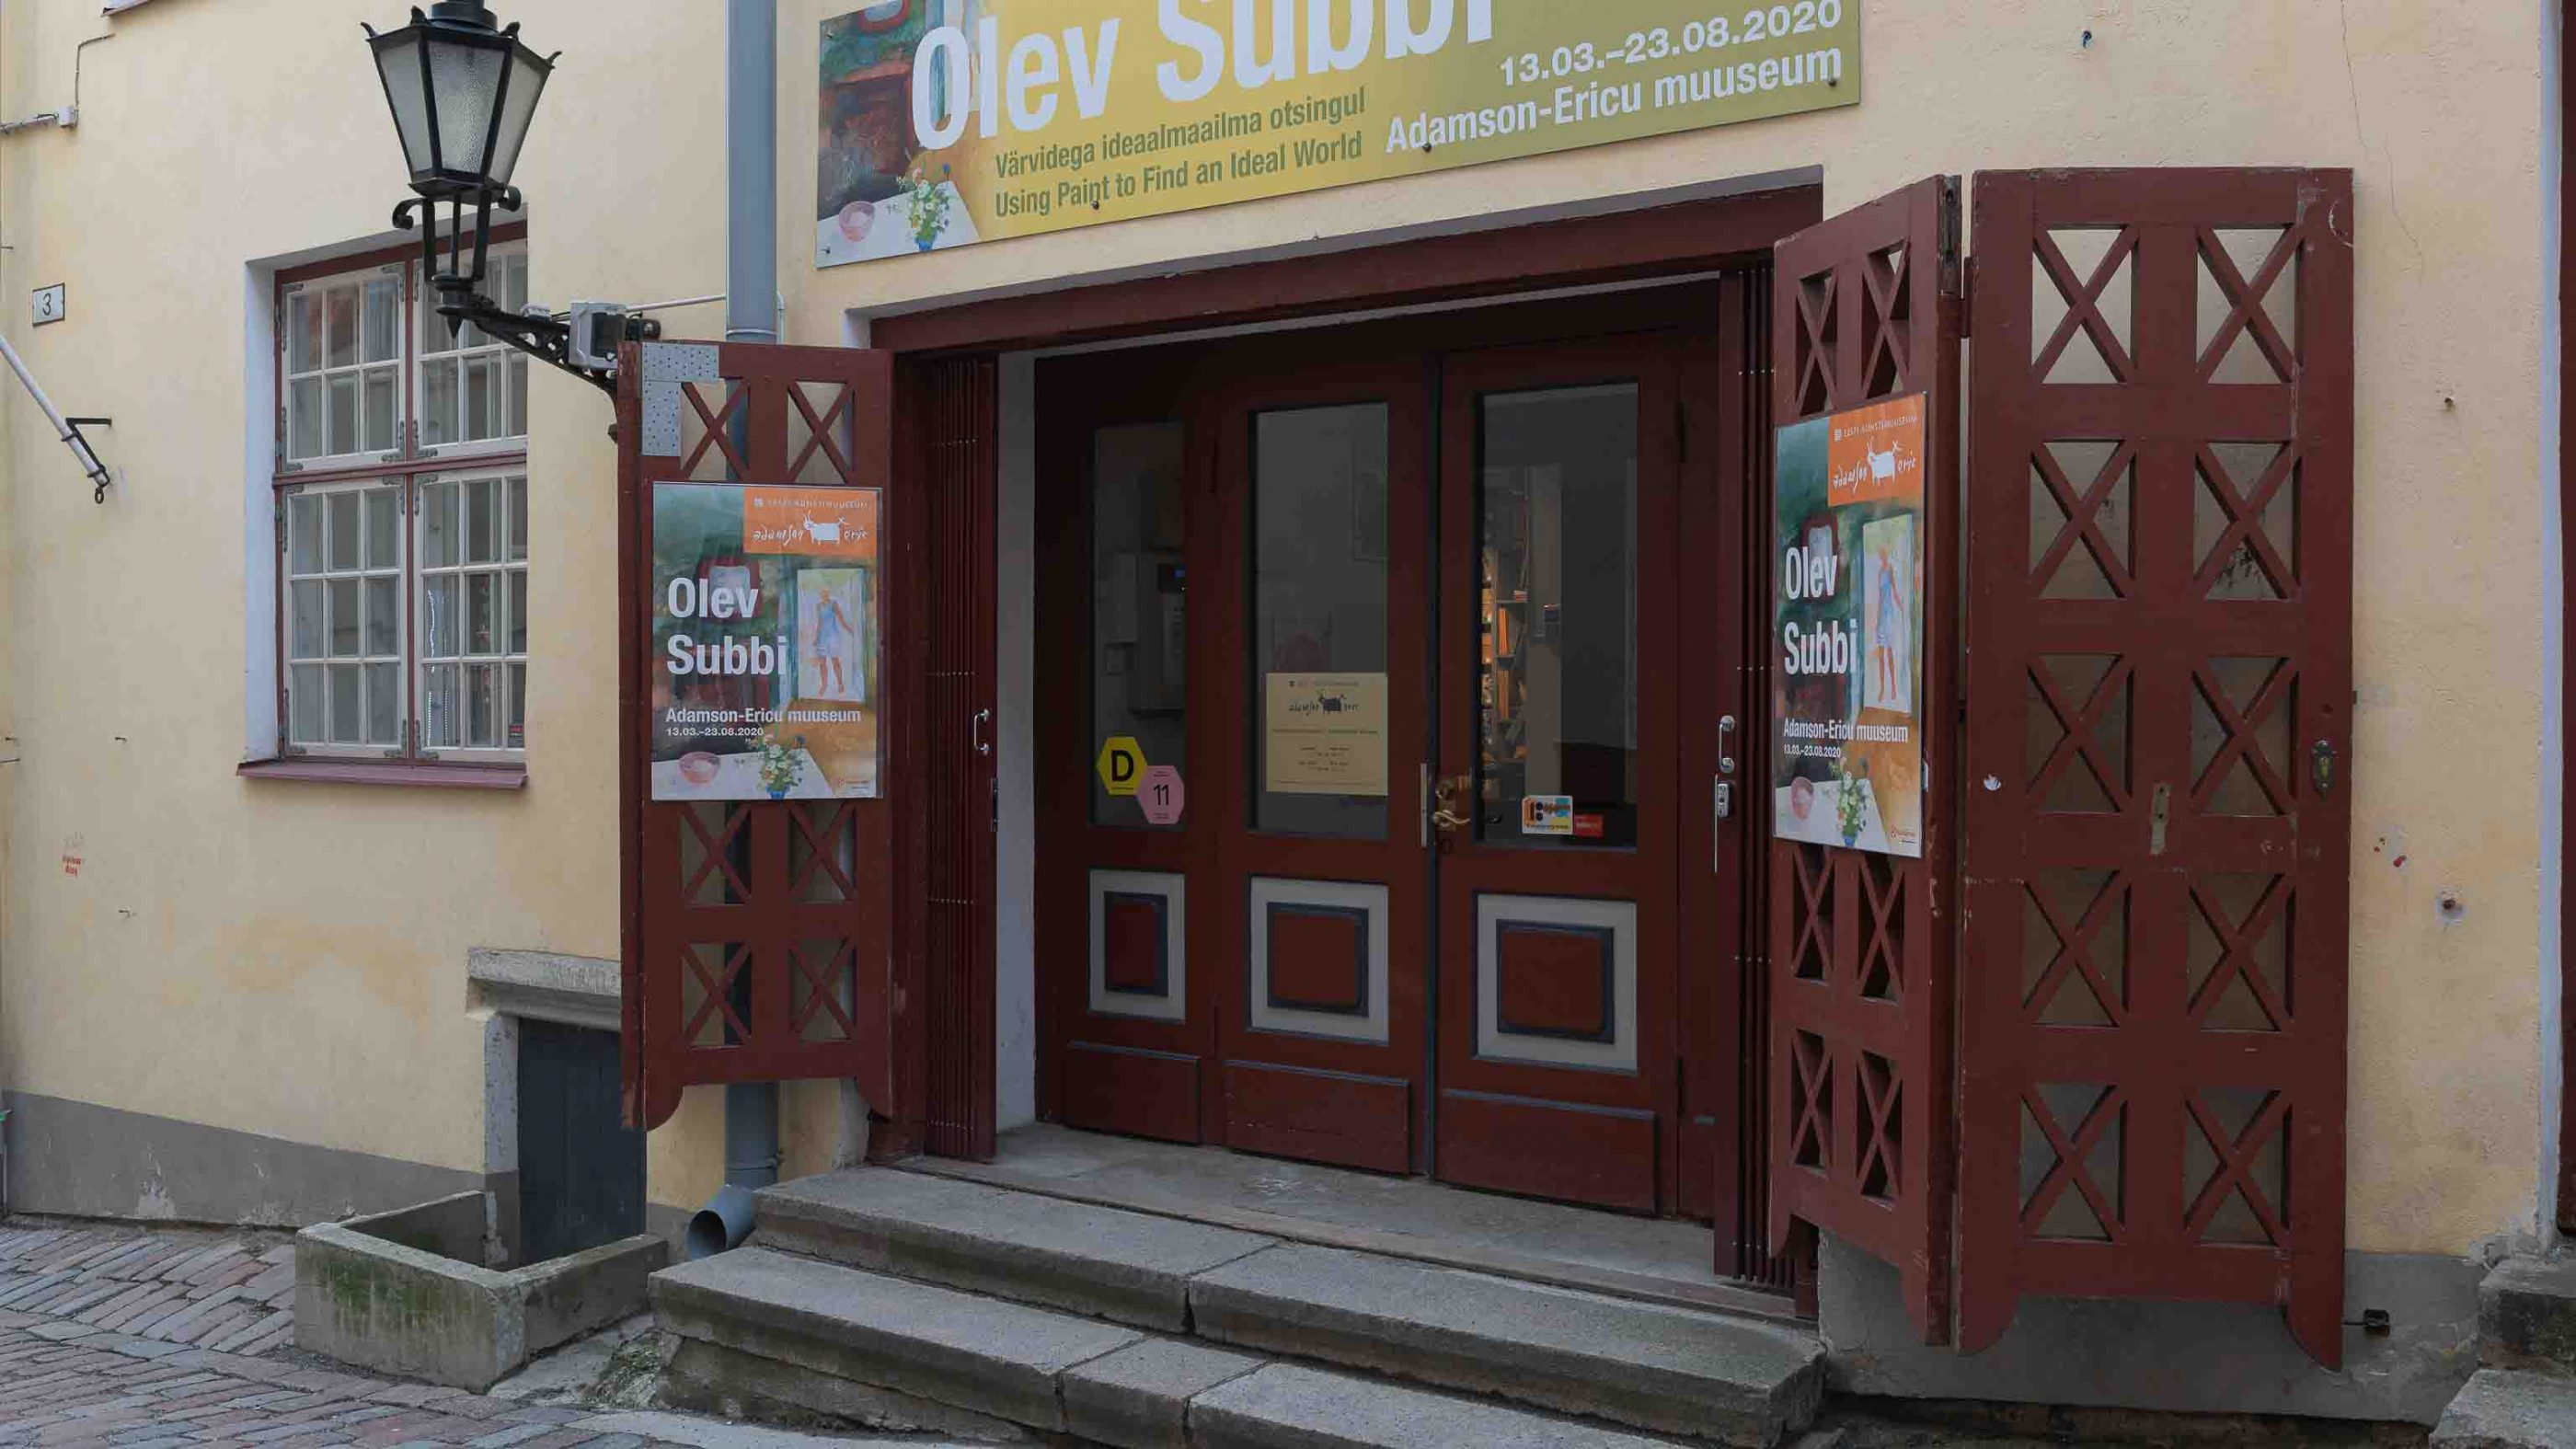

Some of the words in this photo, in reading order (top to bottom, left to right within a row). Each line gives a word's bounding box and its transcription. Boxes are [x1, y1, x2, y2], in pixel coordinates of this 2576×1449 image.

[912, 16, 1121, 151] Olev
[1386, 81, 1641, 154] Adamson-Ericu
[1654, 47, 1841, 109] muuseum
[995, 140, 1095, 178] Värvidega
[1103, 112, 1261, 160] ideaalmaailma
[1270, 86, 1366, 133] otsingul
[995, 190, 1051, 220] Using
[1057, 178, 1108, 209] Paint
[1114, 176, 1136, 196] to
[1143, 162, 1189, 193] Find
[1195, 162, 1224, 184] an
[1231, 144, 1286, 180] Ideal
[1293, 132, 1363, 170] World
[42, 293, 52, 316] 3
[1786, 547, 1837, 600] Olev
[668, 578, 759, 618] Olev
[667, 634, 788, 675] Subbi
[1784, 618, 1858, 675] Subbi
[665, 707, 782, 723] Adamson-Ericu
[788, 710, 861, 723] muuseum
[1783, 718, 1853, 739] Adamson-Ericu
[1857, 724, 1909, 743] muuseum
[1111, 750, 1134, 782] D
[1153, 784, 1169, 806] 11
